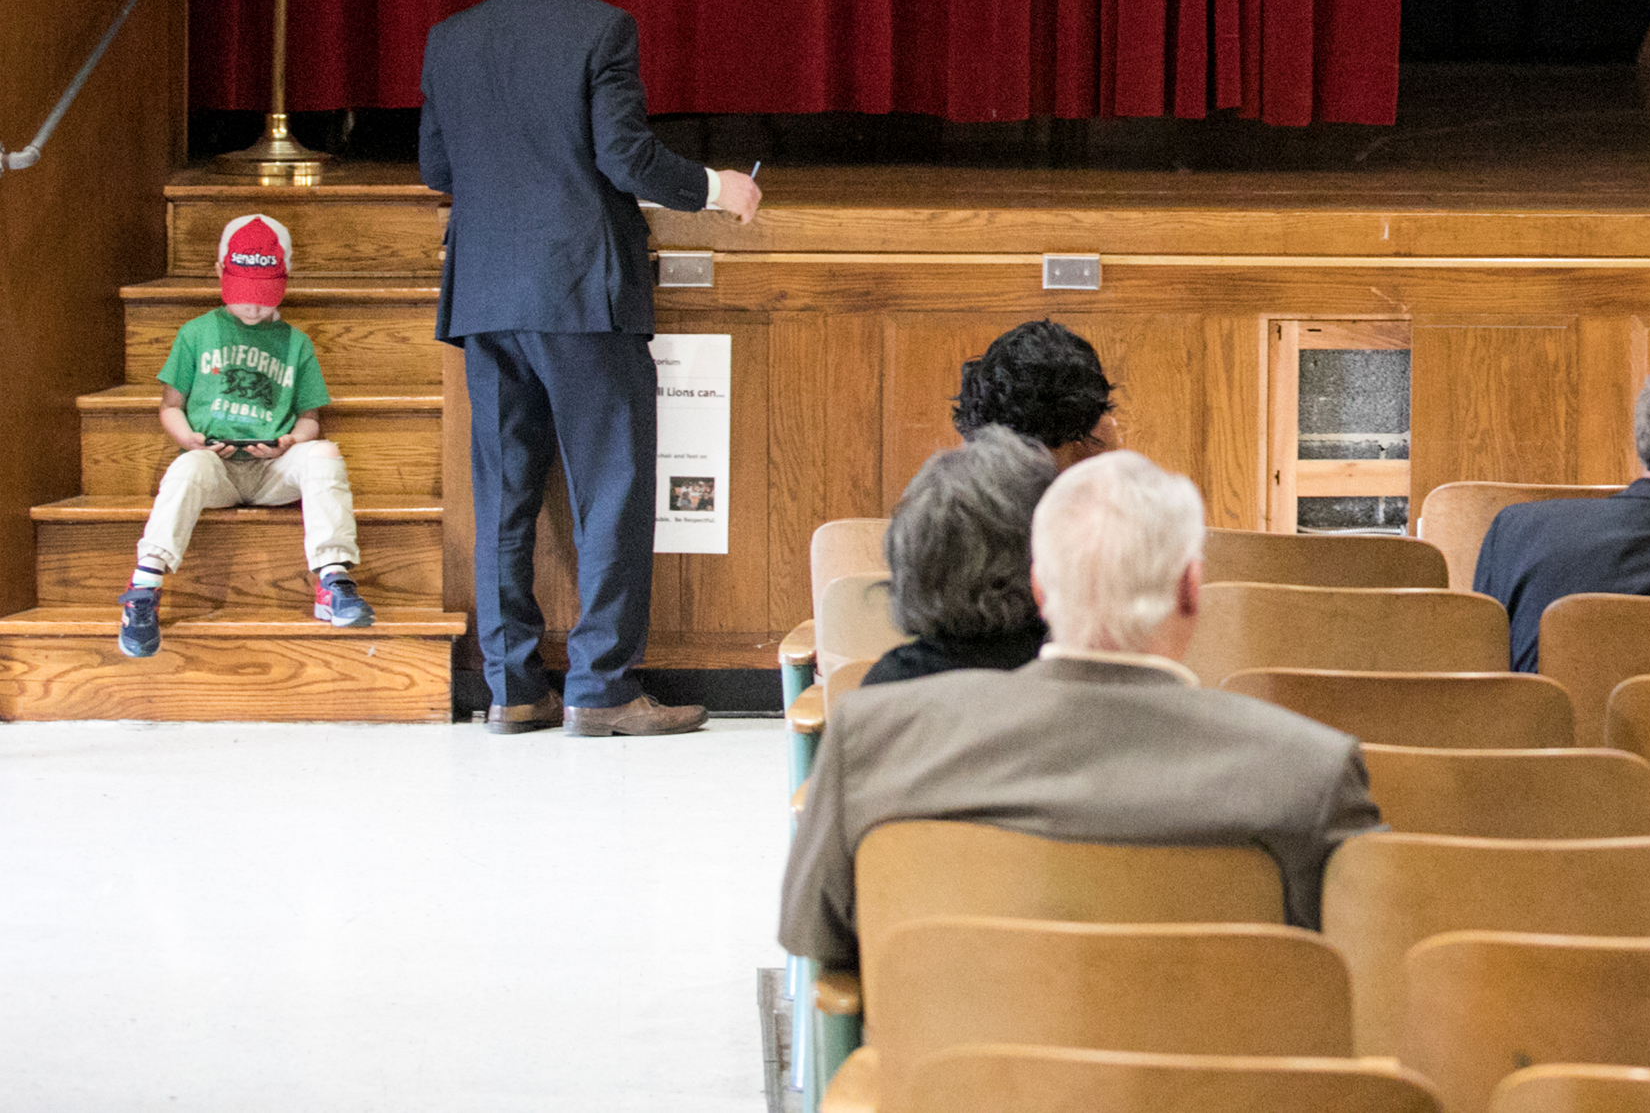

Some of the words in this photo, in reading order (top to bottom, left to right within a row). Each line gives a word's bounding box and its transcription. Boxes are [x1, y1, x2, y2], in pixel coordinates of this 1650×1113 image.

[231, 252, 277, 266] senators
[201, 345, 295, 388] CALIFORNIA
[667, 387, 695, 398] Lions
